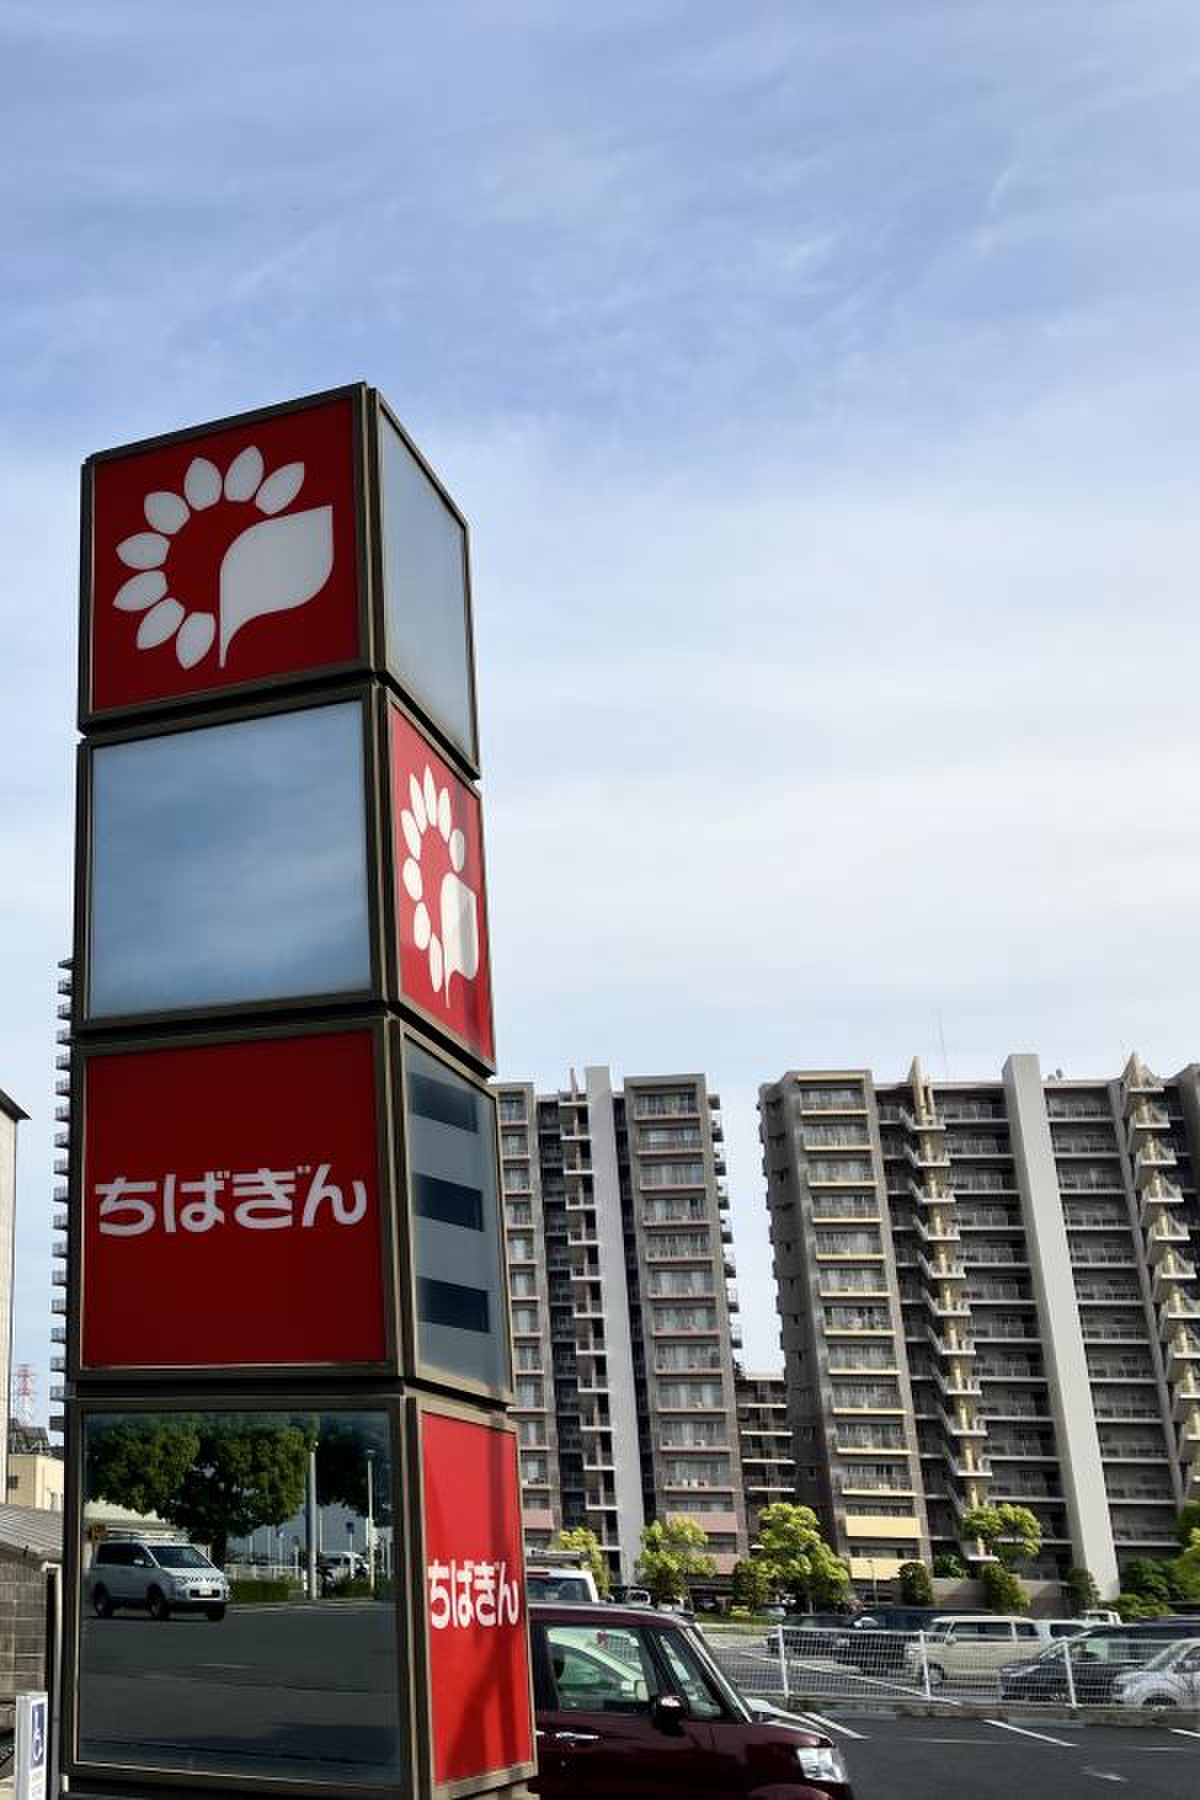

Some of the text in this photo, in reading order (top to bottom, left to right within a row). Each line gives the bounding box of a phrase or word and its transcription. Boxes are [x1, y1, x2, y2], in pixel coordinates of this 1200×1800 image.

[95, 1163, 368, 1237] ちばぎん
[428, 1559, 519, 1629] ちばぎん
